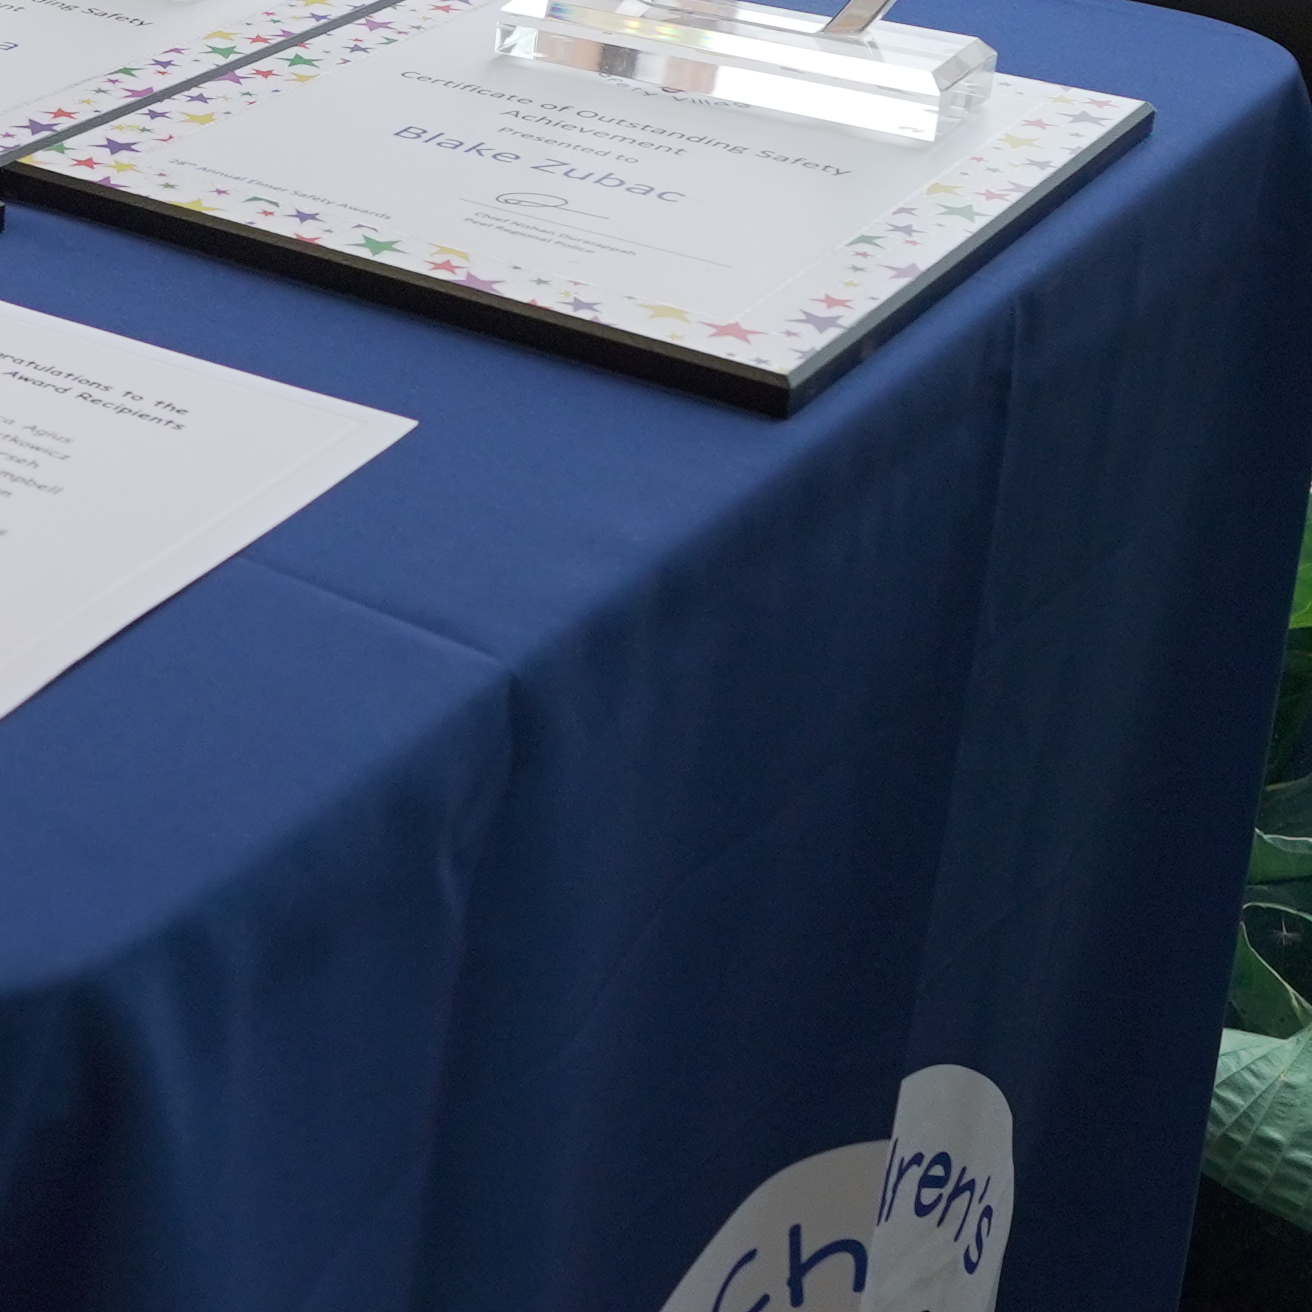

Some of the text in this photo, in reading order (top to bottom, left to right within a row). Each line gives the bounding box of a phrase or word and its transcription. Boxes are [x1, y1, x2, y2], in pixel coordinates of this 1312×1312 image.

[82, 8, 152, 26] Safety
[401, 72, 851, 176] Certificate of Outstanding Safety
[498, 127, 639, 163] Presented to
[500, 110, 686, 155] Achievement
[393, 126, 685, 202] Blake Zubac
[3, 371, 72, 394] Award
[76, 392, 184, 430] Recipients
[123, 391, 143, 401] to
[154, 401, 188, 414] the
